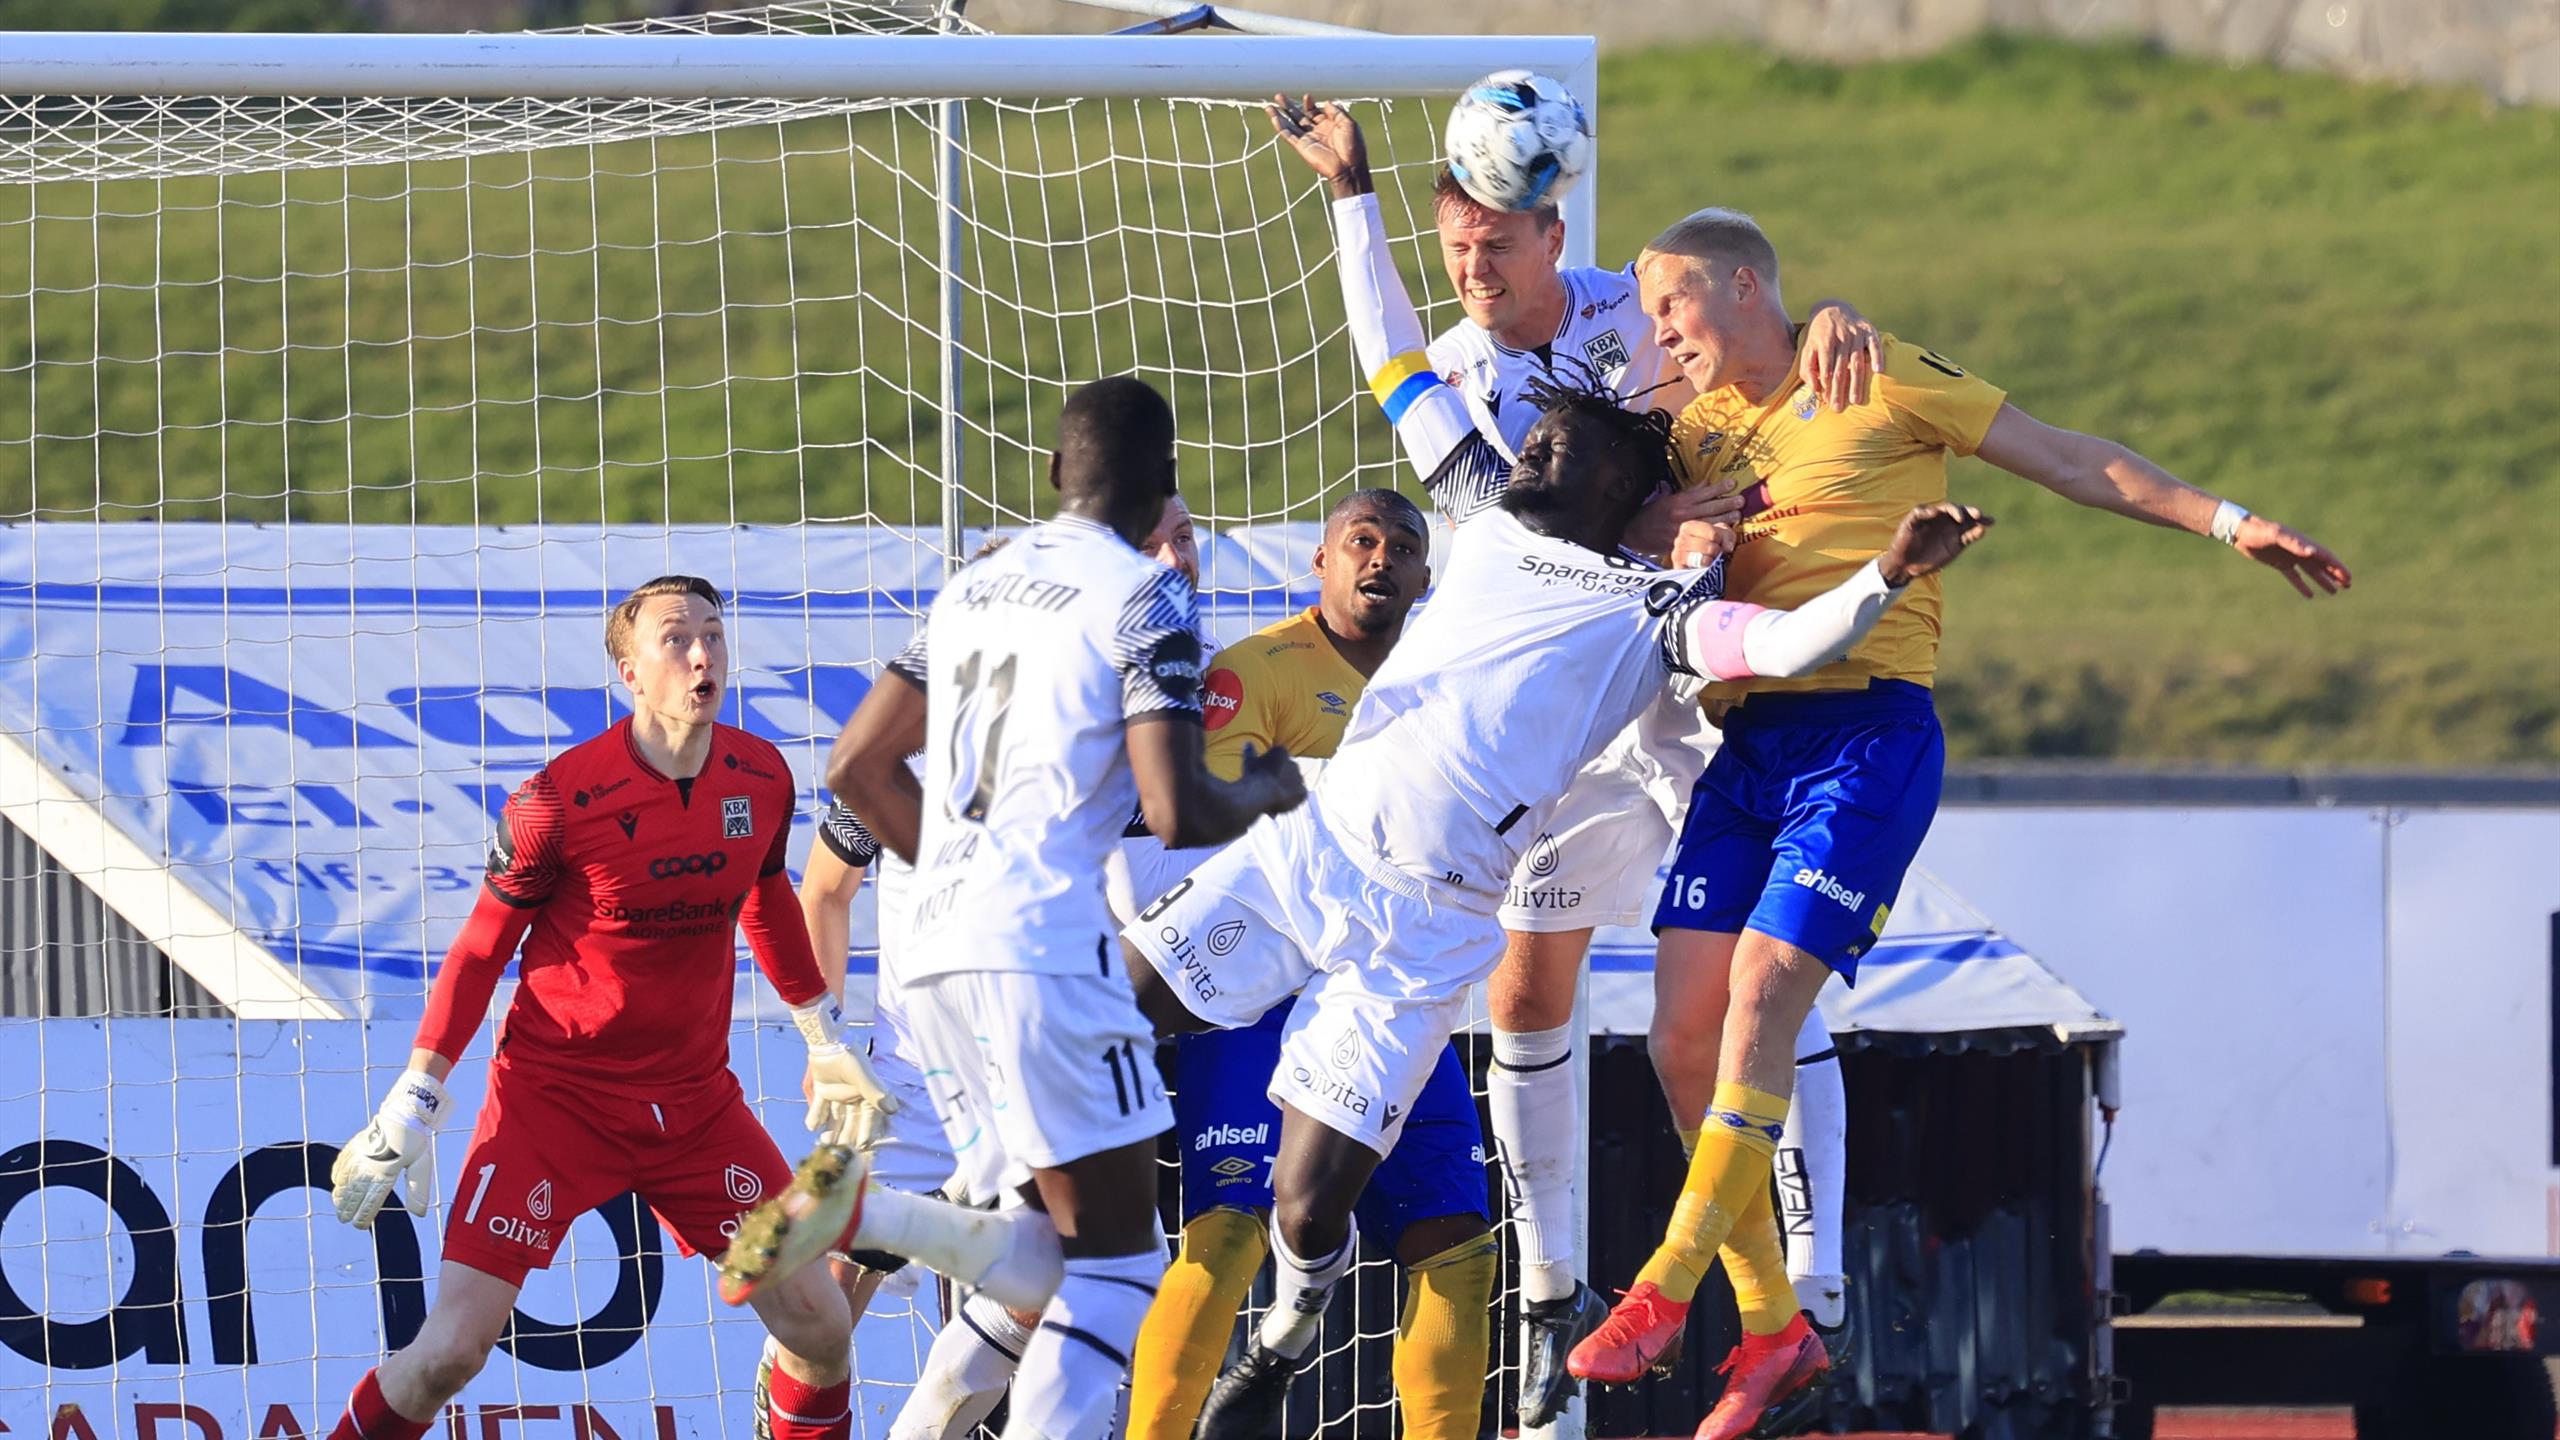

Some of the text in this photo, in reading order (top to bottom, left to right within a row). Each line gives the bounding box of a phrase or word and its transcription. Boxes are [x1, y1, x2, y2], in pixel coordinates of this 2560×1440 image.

[650, 851, 727, 880] coop
[594, 897, 725, 924] SpareBank
[1672, 874, 1707, 910] 16
[1793, 868, 1866, 912] ahlsell
[1160, 926, 1217, 1003] olivita
[1102, 1038, 1146, 1117] 11
[1293, 1067, 1369, 1117] olivita
[1195, 1123, 1269, 1151] ahlsell
[464, 1162, 496, 1224] 1
